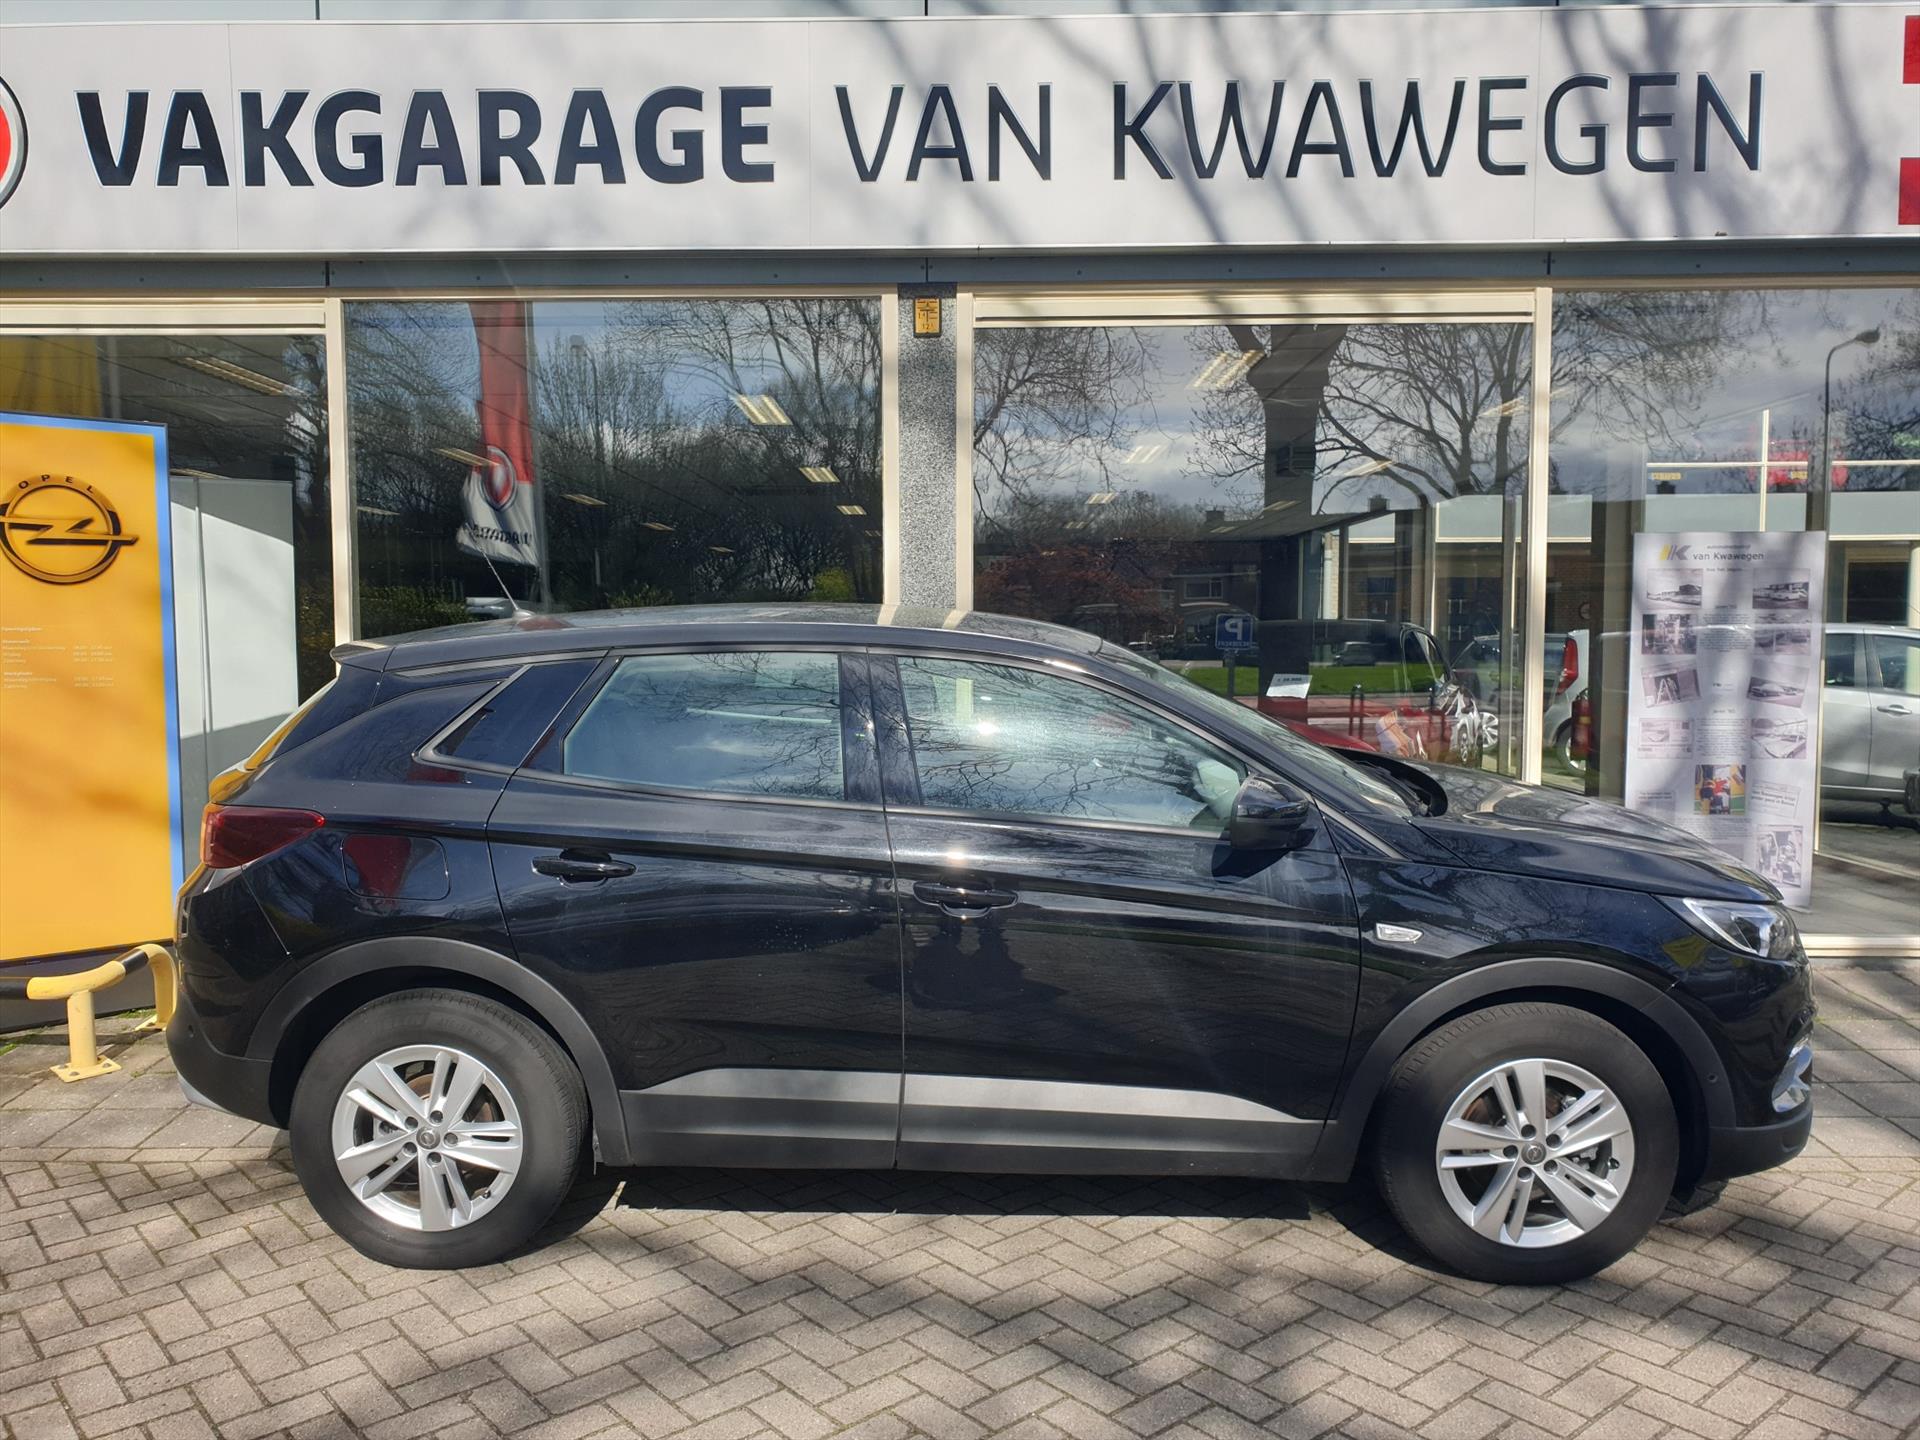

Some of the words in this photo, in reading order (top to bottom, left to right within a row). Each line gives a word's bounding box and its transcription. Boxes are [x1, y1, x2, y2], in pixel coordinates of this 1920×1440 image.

[76, 86, 776, 187] VAKGARAGE
[835, 82, 1052, 183] VAN
[1112, 71, 1764, 182] KWAWEGEN
[18, 474, 94, 494] OPEL
[1713, 552, 1764, 561] Kwawegen
